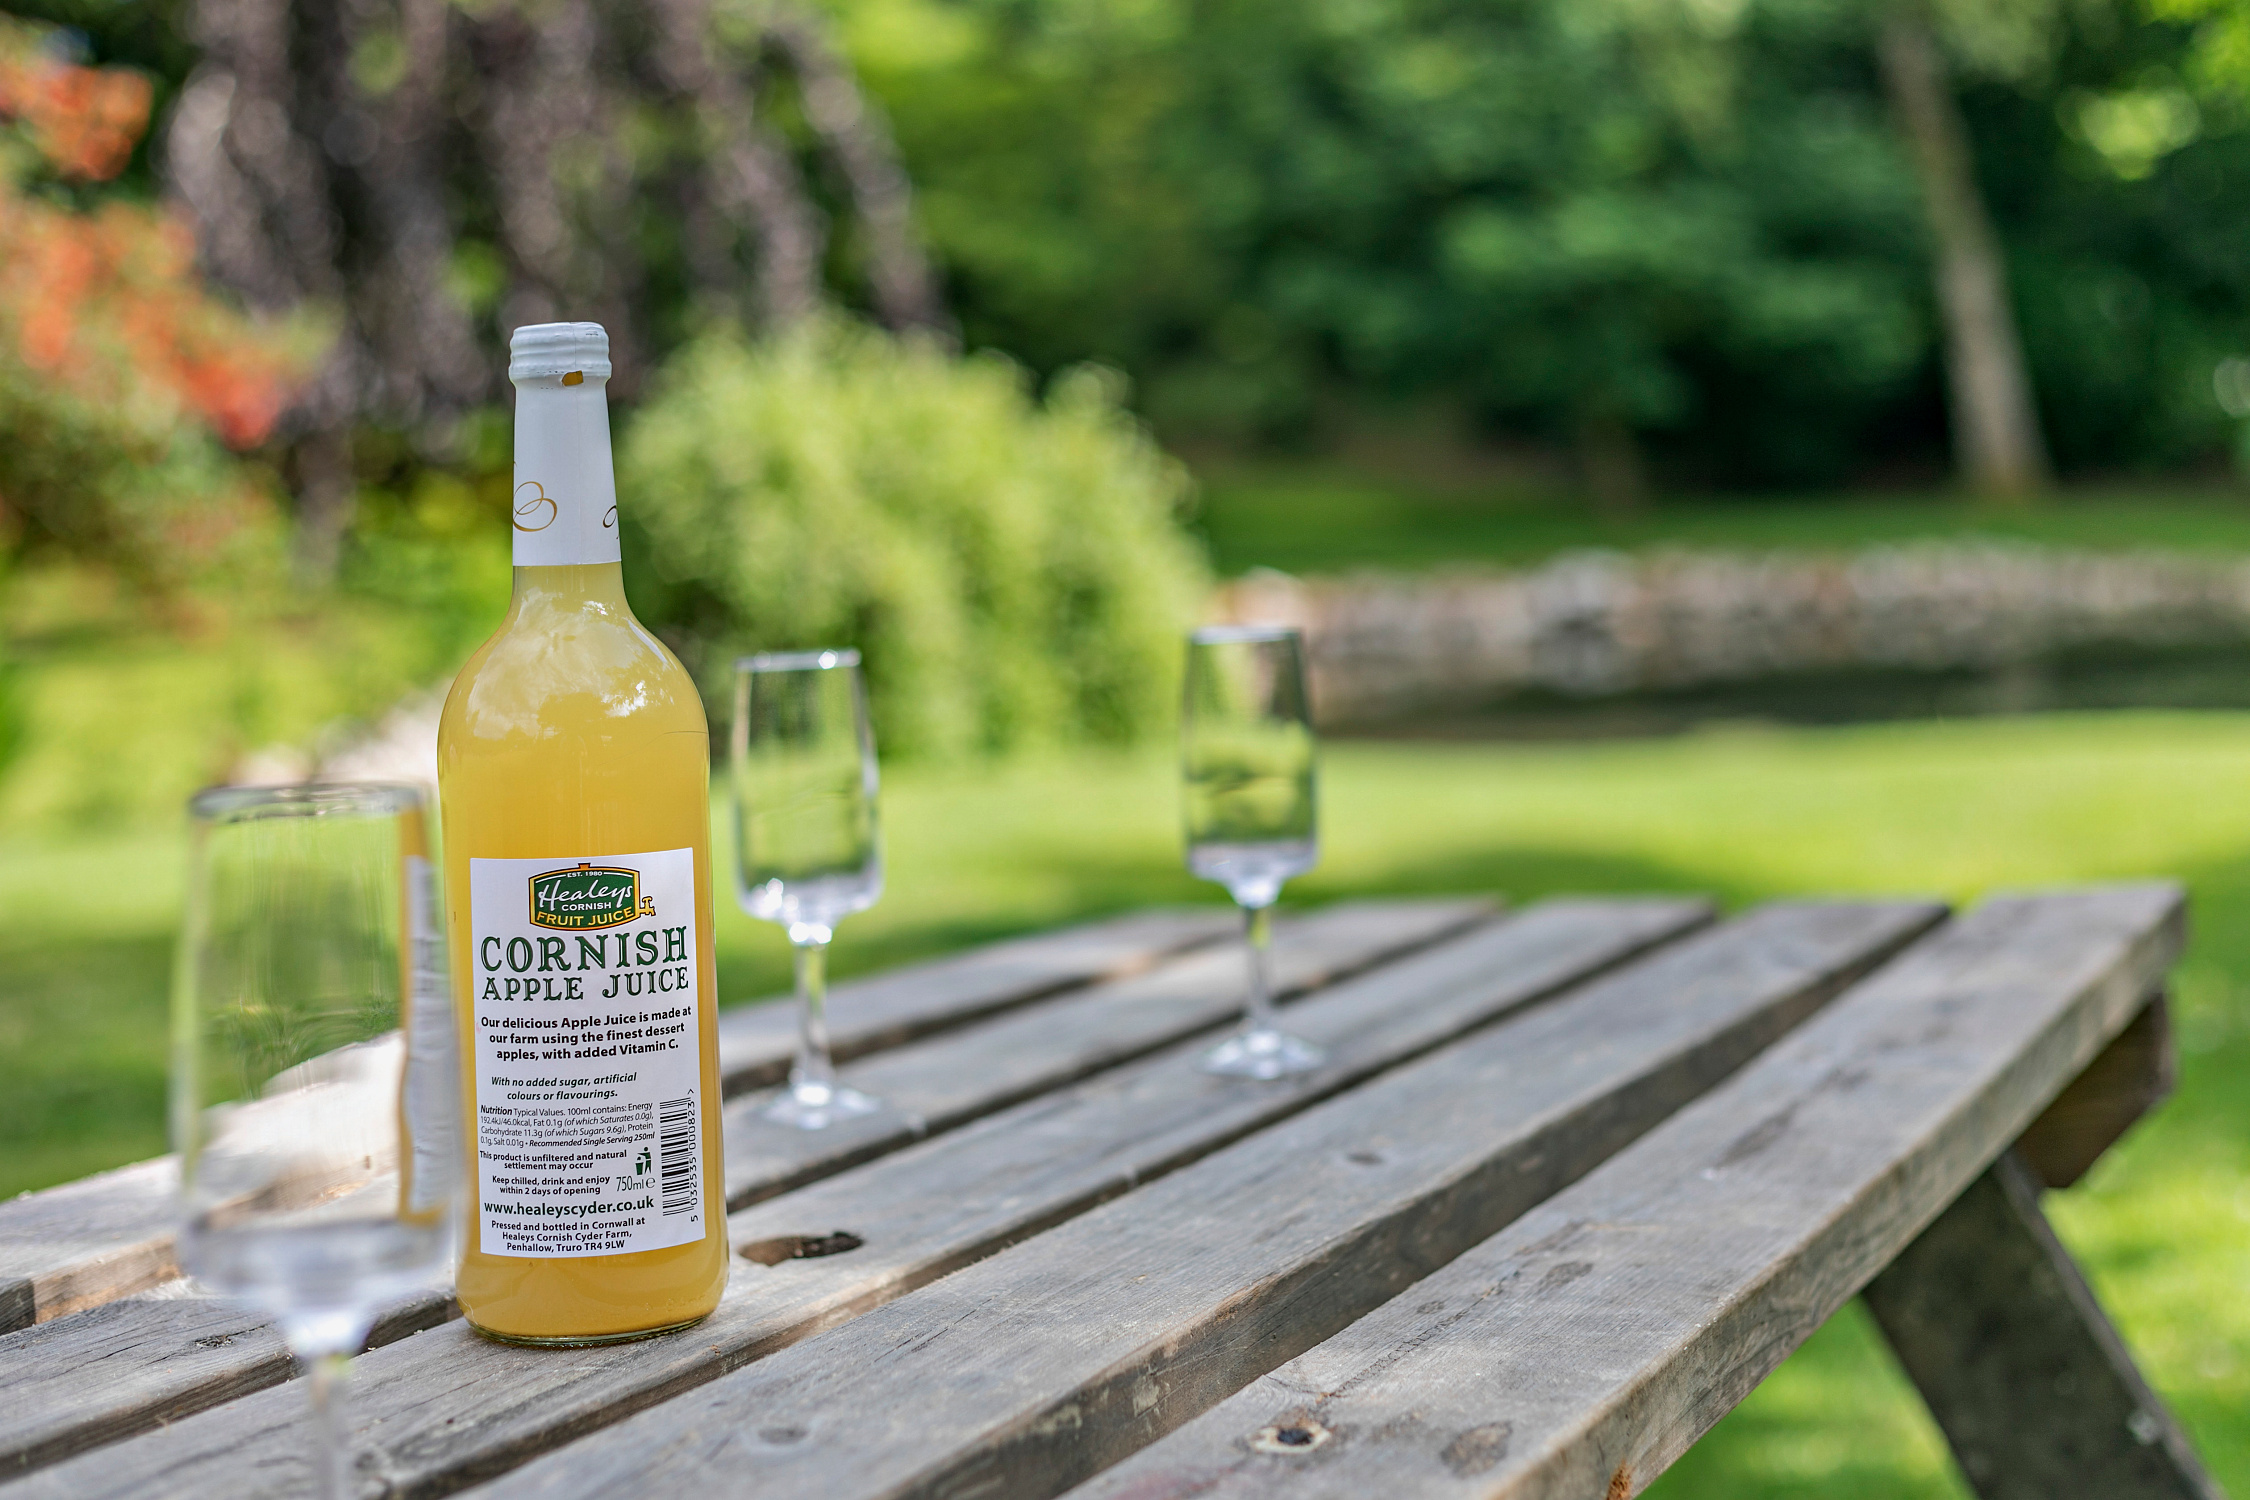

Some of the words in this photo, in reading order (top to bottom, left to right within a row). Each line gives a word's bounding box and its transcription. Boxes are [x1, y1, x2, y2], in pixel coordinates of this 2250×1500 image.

[538, 880, 633, 911] Healeys
[562, 902, 612, 911] CORNISH
[536, 911, 584, 926] FRUIT
[588, 906, 634, 926] JUICE
[481, 926, 688, 972] CORNISH
[482, 977, 583, 1001] APPLE
[602, 967, 689, 999] JUICE
[481, 1017, 500, 1027] Our
[503, 1018, 558, 1029] delicious
[561, 1016, 601, 1030] Apple
[604, 1014, 636, 1026] Juice
[639, 1012, 648, 1022] is
[651, 1007, 680, 1021] made
[683, 1006, 691, 1016] at
[489, 1035, 508, 1043] our
[510, 1034, 539, 1044] farm
[542, 1034, 578, 1045] using
[582, 1032, 604, 1042] the
[606, 1029, 643, 1041] finest
[646, 1023, 685, 1037] dessert
[497, 1049, 539, 1061] apples,
[542, 1048, 571, 1059] with
[574, 1047, 617, 1059] added
[620, 1041, 666, 1055] Vitamin
[669, 1039, 678, 1049] C.
[491, 1077, 510, 1086] With
[526, 1077, 557, 1087] added
[559, 1077, 591, 1088] sugar,
[594, 1072, 637, 1085] artificial
[507, 1091, 540, 1100] colours
[543, 1092, 554, 1100] or
[556, 1089, 618, 1100] flavourings.
[481, 1105, 513, 1115] Nutrition
[514, 1109, 538, 1118] Typical
[568, 1107, 590, 1115] 100ml
[593, 1104, 627, 1113] contains:
[628, 1102, 653, 1111] Energy
[533, 1119, 544, 1127] Fat
[546, 1119, 563, 1128] 0.1g
[564, 1117, 575, 1127] (of
[576, 1117, 598, 1126] which
[600, 1115, 634, 1124] Saturates
[687, 1101, 697, 1150] 000823
[481, 1126, 522, 1137] Carbohydrate
[524, 1128, 542, 1138] 11.3g
[545, 1127, 556, 1137] (of
[556, 1127, 578, 1135] which
[580, 1126, 605, 1136] Sugars
[606, 1124, 626, 1133] 9.6g),
[628, 1122, 653, 1131] Protein
[506, 1138, 524, 1148] 0.01g
[530, 1138, 582, 1147] Recommended
[583, 1136, 605, 1145] Single
[606, 1134, 633, 1144] Serving
[634, 1131, 655, 1142] 250ml
[480, 1151, 492, 1159] This
[493, 1152, 522, 1162] product
[532, 1152, 574, 1161] unfiltered
[577, 1151, 593, 1160] and
[595, 1150, 627, 1159] natural
[504, 1161, 549, 1170] settlement
[551, 1162, 567, 1171] may
[569, 1161, 594, 1169] occur
[492, 1176, 509, 1186] Keep
[511, 1177, 540, 1186] chilled,
[542, 1177, 564, 1185] drink
[567, 1177, 583, 1185] and
[585, 1176, 610, 1186] enjoy
[616, 1176, 644, 1192] 750ml
[688, 1156, 698, 1206] 032535
[500, 1186, 523, 1195] within
[532, 1186, 551, 1196] days
[553, 1186, 562, 1194] of
[564, 1186, 601, 1197] opening
[484, 1196, 654, 1219] www.healeyscyder.co.uk
[491, 1221, 521, 1230] Pressed
[523, 1223, 540, 1231] and
[542, 1221, 578, 1231] bottled
[580, 1222, 590, 1230] in
[592, 1218, 634, 1229] Cornwall
[636, 1217, 645, 1225] at
[502, 1232, 535, 1242] Healeys
[537, 1233, 572, 1242] Cornish
[575, 1232, 603, 1242] Cyder
[606, 1230, 632, 1238] Farm,
[507, 1242, 555, 1252] Penhallow,
[556, 1243, 582, 1252] Truro
[584, 1242, 603, 1251] TR4
[605, 1240, 625, 1249] 9LW
